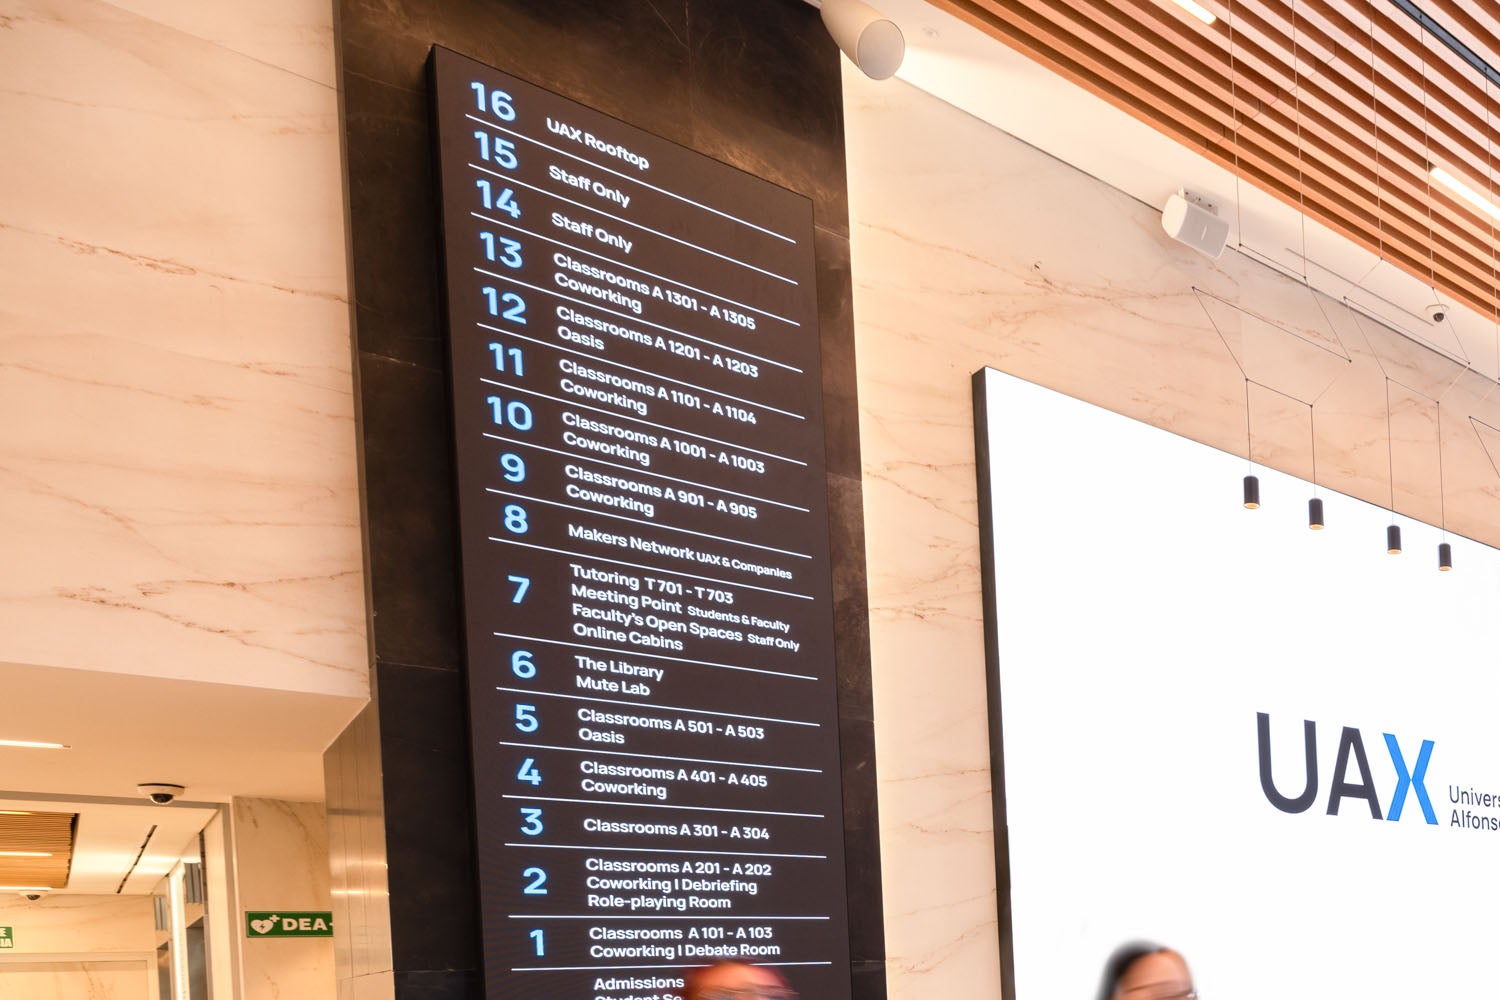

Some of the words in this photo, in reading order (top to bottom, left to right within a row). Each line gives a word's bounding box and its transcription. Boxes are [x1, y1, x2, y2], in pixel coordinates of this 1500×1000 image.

[470, 81, 516, 122] 16
[474, 130, 518, 170] 15
[546, 117, 583, 144] UAX
[584, 132, 650, 171] Rooftop
[475, 179, 522, 219] 14
[548, 165, 592, 192] Staff
[592, 181, 631, 209] Only
[551, 212, 594, 238] Staff
[594, 227, 633, 254] Only
[479, 231, 523, 269] 13
[482, 286, 527, 325] 12
[553, 252, 651, 296] Classrooms
[651, 285, 664, 300] A
[665, 289, 698, 312] 1301
[709, 304, 721, 319] A
[722, 308, 756, 330] 1305
[554, 272, 643, 315] Coworking
[556, 305, 653, 346] Classrooms
[654, 335, 667, 351] A
[667, 339, 701, 361] 1201
[712, 353, 724, 368] A
[724, 357, 759, 378] 1203
[557, 325, 605, 351] Oasis
[488, 341, 524, 377] 11
[558, 358, 656, 397] Classrooms
[656, 386, 670, 401] A
[670, 389, 701, 410] 1101
[712, 401, 724, 416] A
[724, 405, 757, 425] 1104
[560, 378, 648, 416] Coworking
[486, 395, 533, 431] 10
[561, 411, 659, 447] Classrooms
[659, 436, 672, 451] A
[673, 439, 707, 460] 1001
[718, 451, 730, 466] A
[730, 454, 765, 474] 1003
[563, 431, 651, 467] Coworking
[500, 452, 526, 483] 9
[564, 464, 663, 498] Classrooms
[663, 487, 677, 501] A
[677, 490, 705, 508] 901
[715, 499, 728, 513] A
[728, 501, 758, 520] 905
[565, 483, 655, 518] Coworking
[503, 503, 529, 534] 8
[568, 523, 629, 548] Makers
[629, 535, 696, 561] Network
[695, 551, 721, 566] UAX
[730, 558, 793, 580] Companies
[507, 574, 530, 604] 7
[569, 563, 640, 592] Tutoring
[571, 583, 640, 610] Meeting
[640, 595, 683, 615] Point
[687, 605, 741, 624] Students
[750, 615, 791, 634] Faculty
[572, 602, 645, 627] Faculty's
[645, 614, 688, 633] Open
[688, 621, 743, 642] Spaces
[747, 633, 775, 647] Staff
[774, 637, 800, 653] Only
[572, 622, 627, 643] Online
[628, 630, 684, 651] Cabins
[511, 649, 537, 679] 6
[574, 655, 608, 672] The
[609, 660, 665, 682] Library
[576, 674, 620, 693] Mute
[621, 680, 651, 697] Lab
[515, 703, 539, 733] 5
[577, 708, 673, 730] Classrooms
[673, 718, 687, 732] A
[687, 719, 713, 735] 501
[724, 724, 737, 737] A
[737, 725, 765, 740] 503
[578, 727, 625, 745] Oasis
[516, 757, 543, 786] 4
[579, 760, 676, 781] Classrooms
[676, 768, 689, 782] A
[690, 769, 716, 784] 401
[727, 772, 739, 785] A
[740, 773, 768, 788] 405
[1256, 711, 1439, 826] UAX
[580, 778, 667, 800] Coworking
[520, 807, 544, 836] 3
[583, 818, 678, 836] Classrooms
[679, 823, 692, 836] A
[692, 824, 719, 837] 301
[729, 826, 741, 839] A
[742, 826, 770, 840] 304
[522, 866, 548, 895] 2
[585, 857, 680, 874] Classrooms
[681, 861, 694, 874] A
[694, 861, 721, 875] 201
[731, 862, 744, 875] A
[744, 863, 773, 876] 202
[586, 876, 672, 894] Coworking
[681, 878, 758, 896] Debriefing
[587, 894, 687, 912] Role-playing
[688, 895, 732, 909] Room
[282, 918, 328, 931] DEA
[588, 926, 684, 940] Classrooms
[687, 927, 700, 939] A
[701, 926, 724, 940] 101
[735, 926, 747, 939] A
[748, 926, 773, 939] 103
[529, 929, 545, 957] 1
[589, 944, 676, 960] Coworking
[684, 944, 739, 957] Debate
[739, 943, 781, 956] Room
[593, 977, 685, 991] Admissions
